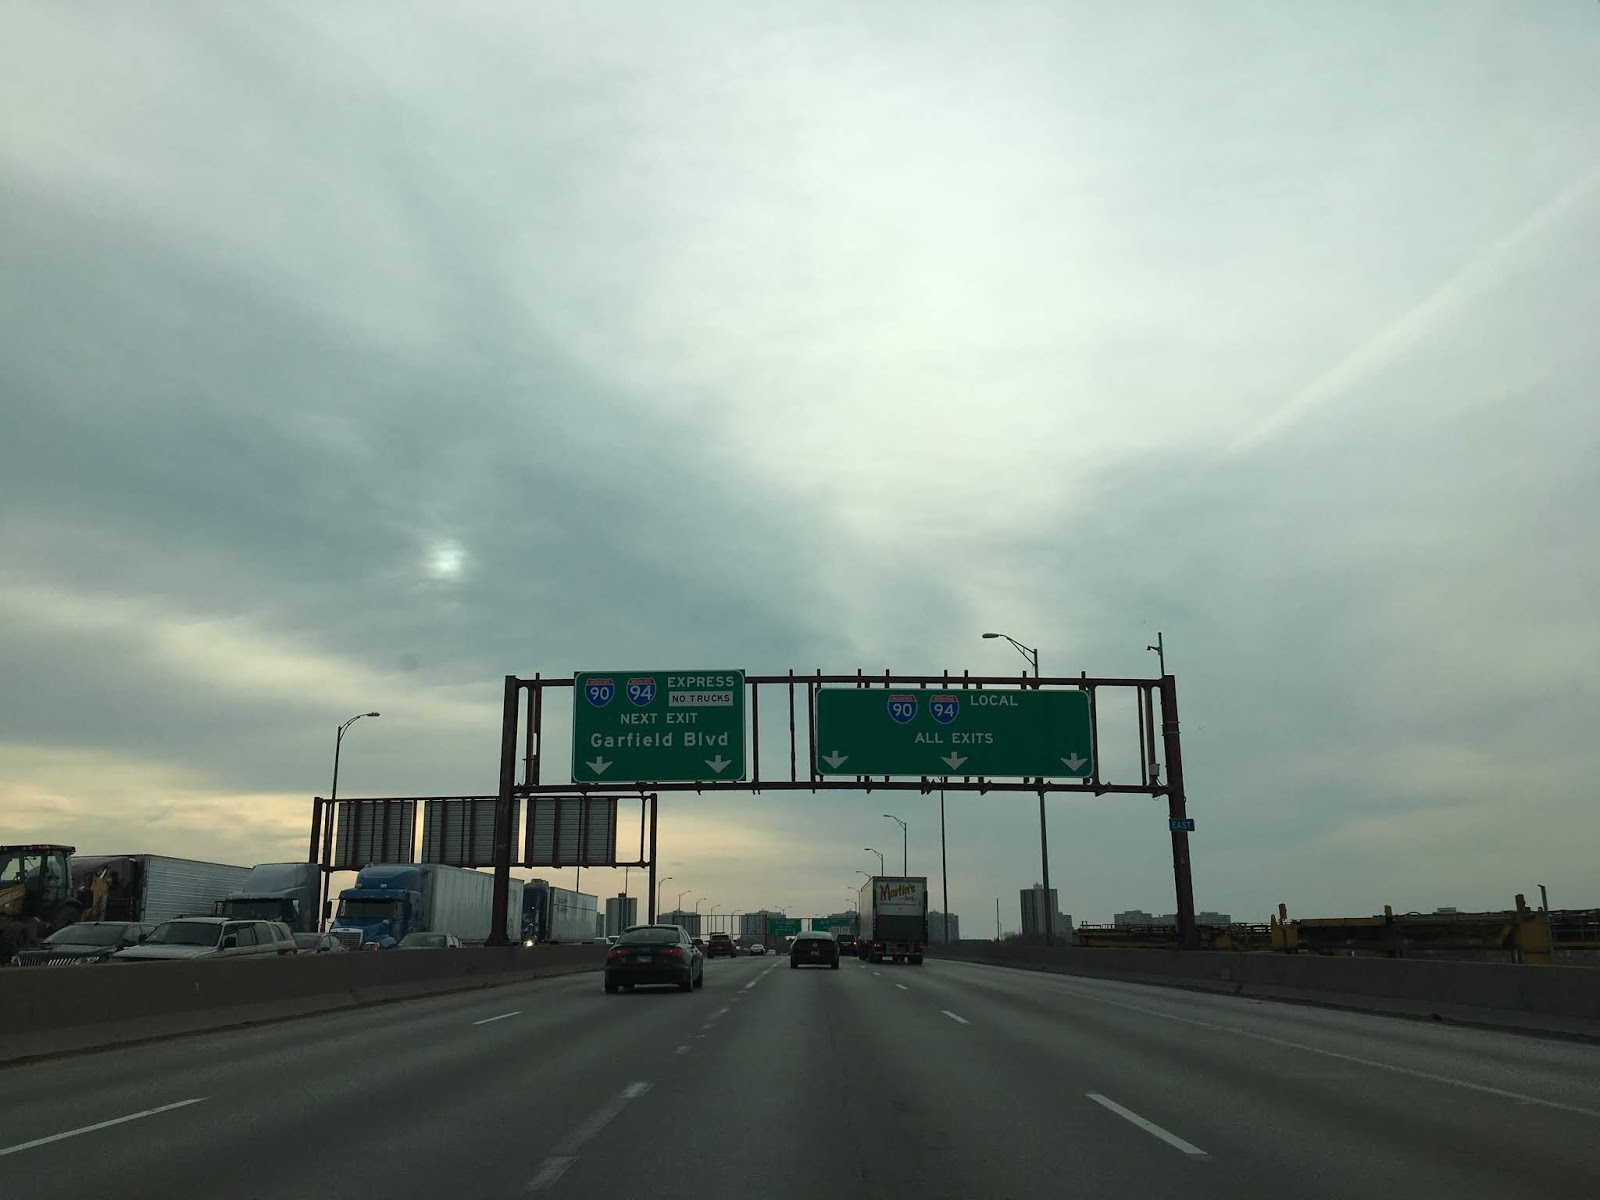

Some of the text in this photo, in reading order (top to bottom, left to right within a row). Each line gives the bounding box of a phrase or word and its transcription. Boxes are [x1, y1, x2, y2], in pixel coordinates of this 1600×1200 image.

[667, 676, 735, 688] EXPRESS
[589, 686, 610, 701] 90
[629, 685, 653, 701] 94
[672, 694, 731, 703] NO TRUCKS
[970, 695, 1019, 706] LOCAL
[892, 703, 913, 717] 90
[933, 703, 955, 717] 94
[620, 712, 699, 725] NEXT EXIT
[590, 731, 729, 748] Garfield Blvd
[914, 732, 994, 744] ALL EXITS
[1172, 820, 1191, 829] EAST
